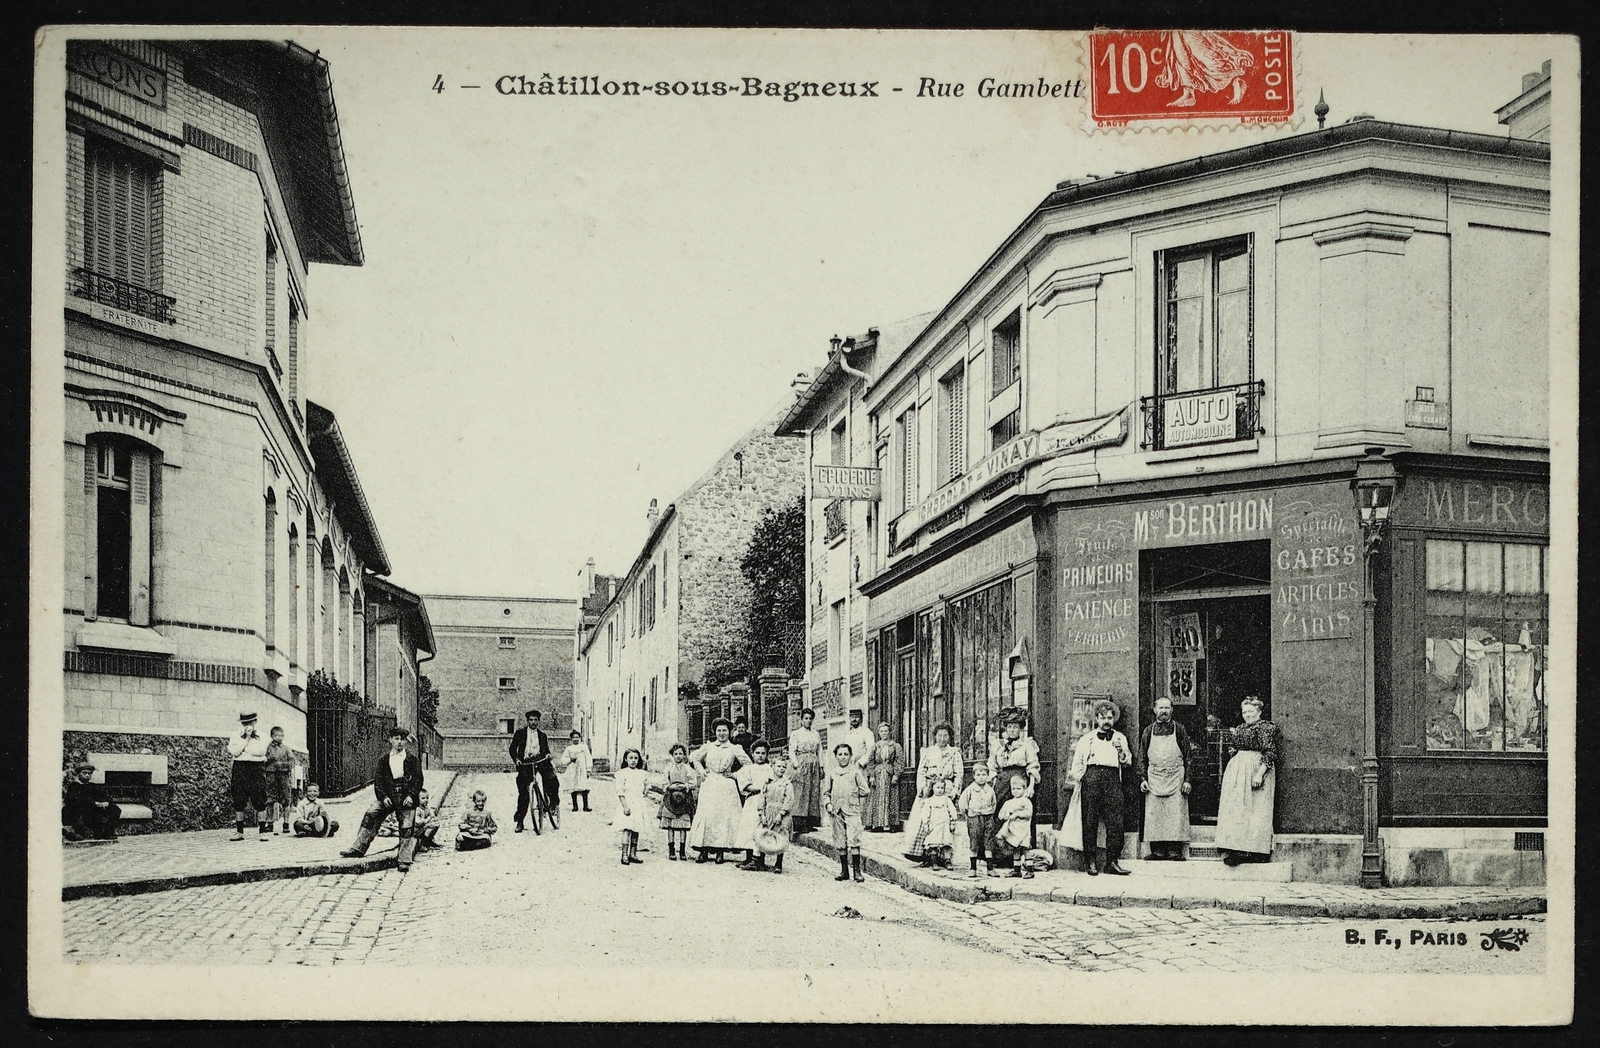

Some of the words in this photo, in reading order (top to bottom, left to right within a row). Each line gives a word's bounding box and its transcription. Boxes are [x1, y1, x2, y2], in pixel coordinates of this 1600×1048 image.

[1170, 395, 1230, 428] AUTO
[1168, 424, 1233, 443] AUTOMOBILINE
[818, 468, 878, 486] EPICERIE
[920, 474, 974, 522] CHOCOLAT
[986, 436, 1035, 477] VINAY
[824, 486, 873, 500] VINS
[1424, 480, 1547, 527] MERC
[1164, 497, 1274, 538] BERTHON
[1277, 545, 1356, 570] CAFES
[1062, 562, 1134, 588] PRIMEURS
[1277, 581, 1359, 602] ARTICLES
[1064, 597, 1134, 620] FAIENCE
[1283, 611, 1351, 634] PARIS
[1068, 624, 1130, 647] VERRERIE
